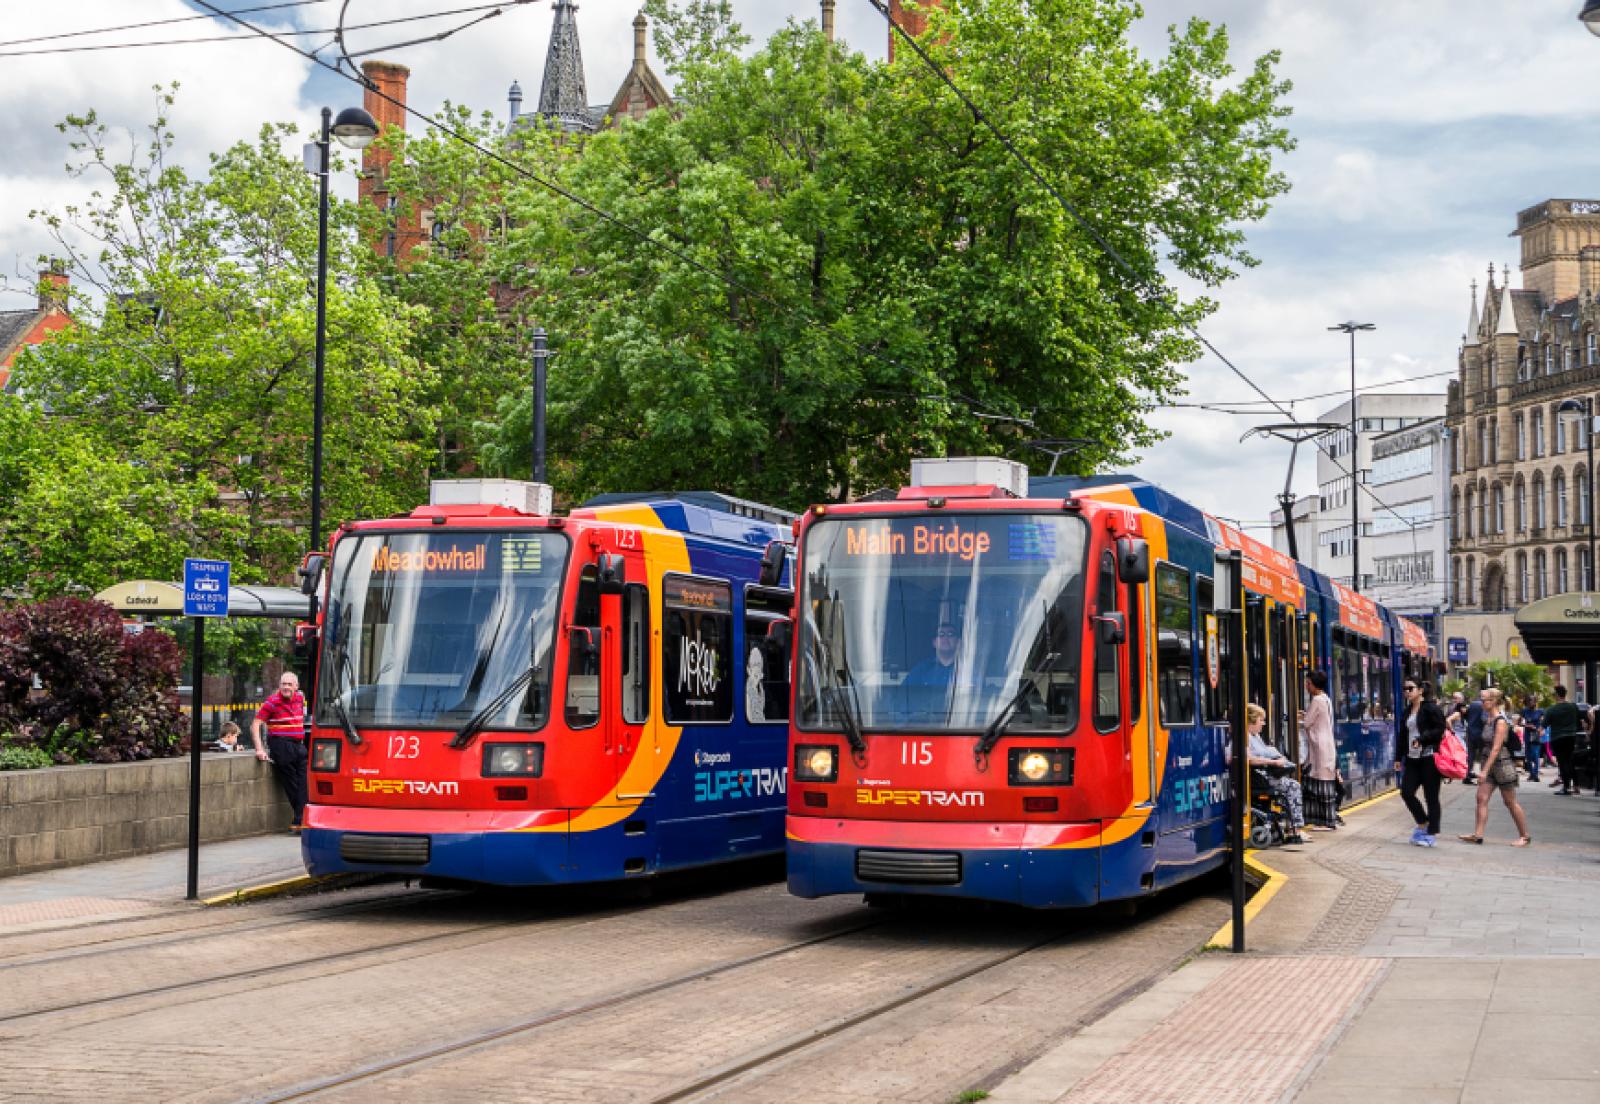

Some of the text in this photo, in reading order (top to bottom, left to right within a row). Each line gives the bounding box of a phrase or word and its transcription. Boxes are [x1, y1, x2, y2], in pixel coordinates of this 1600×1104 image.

[614, 527, 636, 549] 123
[846, 523, 991, 560] Malin Bridge
[371, 544, 486, 571] Meadowhall
[126, 595, 159, 605] Cathedral
[187, 592, 206, 602] LOOK
[387, 735, 421, 759] 123
[901, 741, 933, 765] 115
[353, 778, 460, 795] SUPERTRAM
[856, 788, 985, 807] SUPERTRAM
